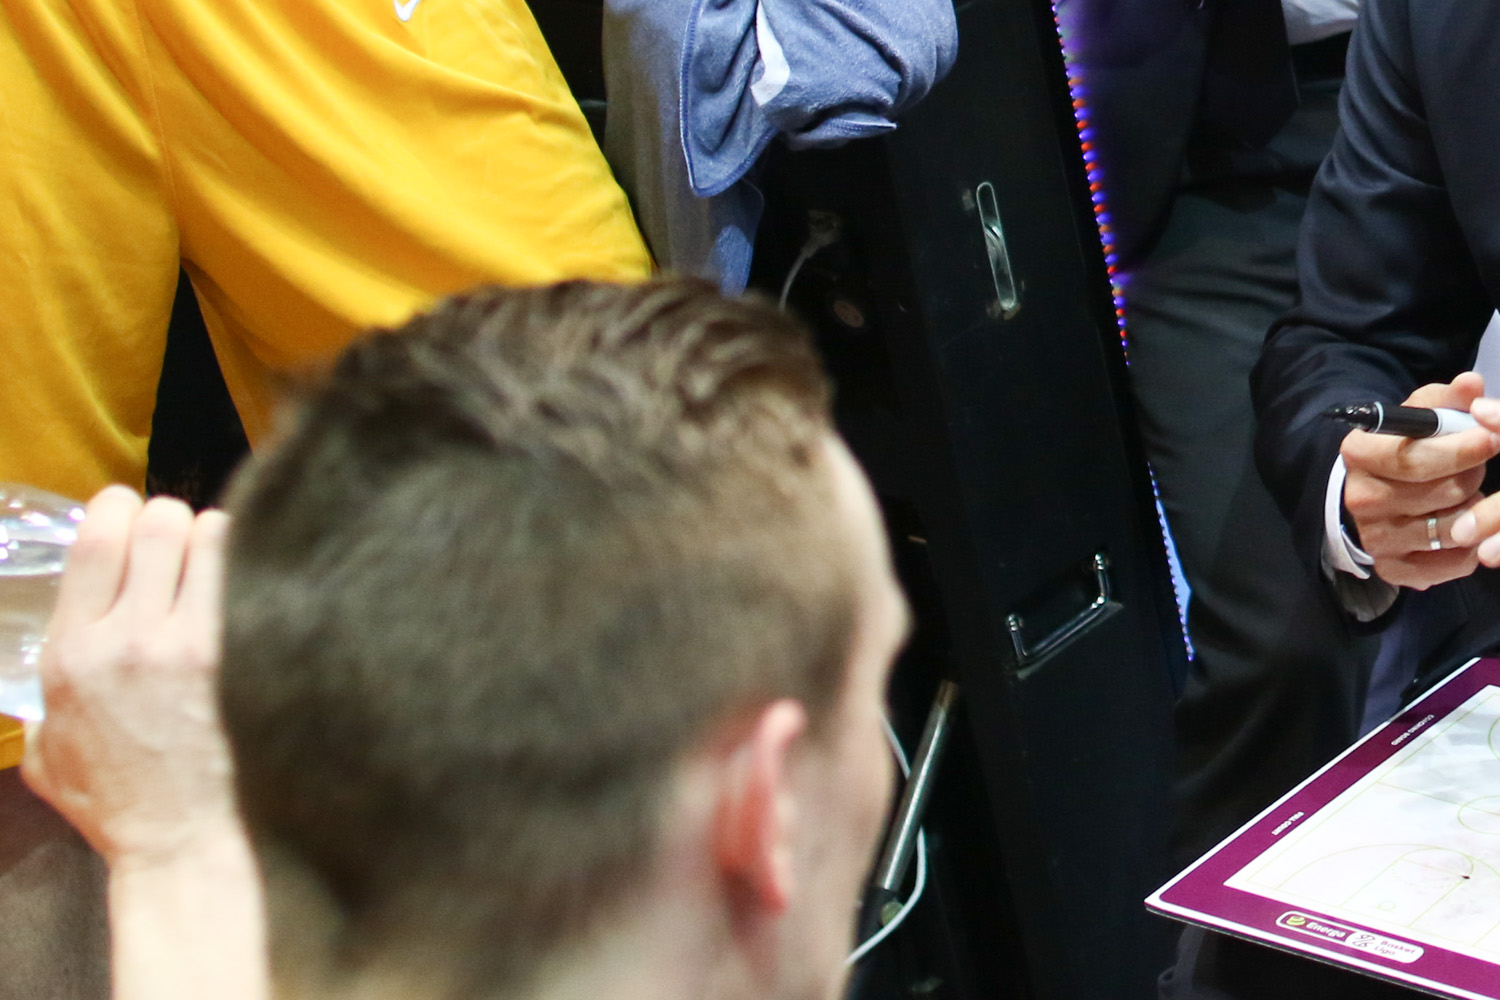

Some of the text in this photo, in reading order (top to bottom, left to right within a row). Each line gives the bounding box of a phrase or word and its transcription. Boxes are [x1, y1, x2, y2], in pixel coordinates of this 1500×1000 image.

[1305, 921, 1347, 938] Energa
[1374, 945, 1396, 956] Liga
[1381, 940, 1416, 954] Basket
